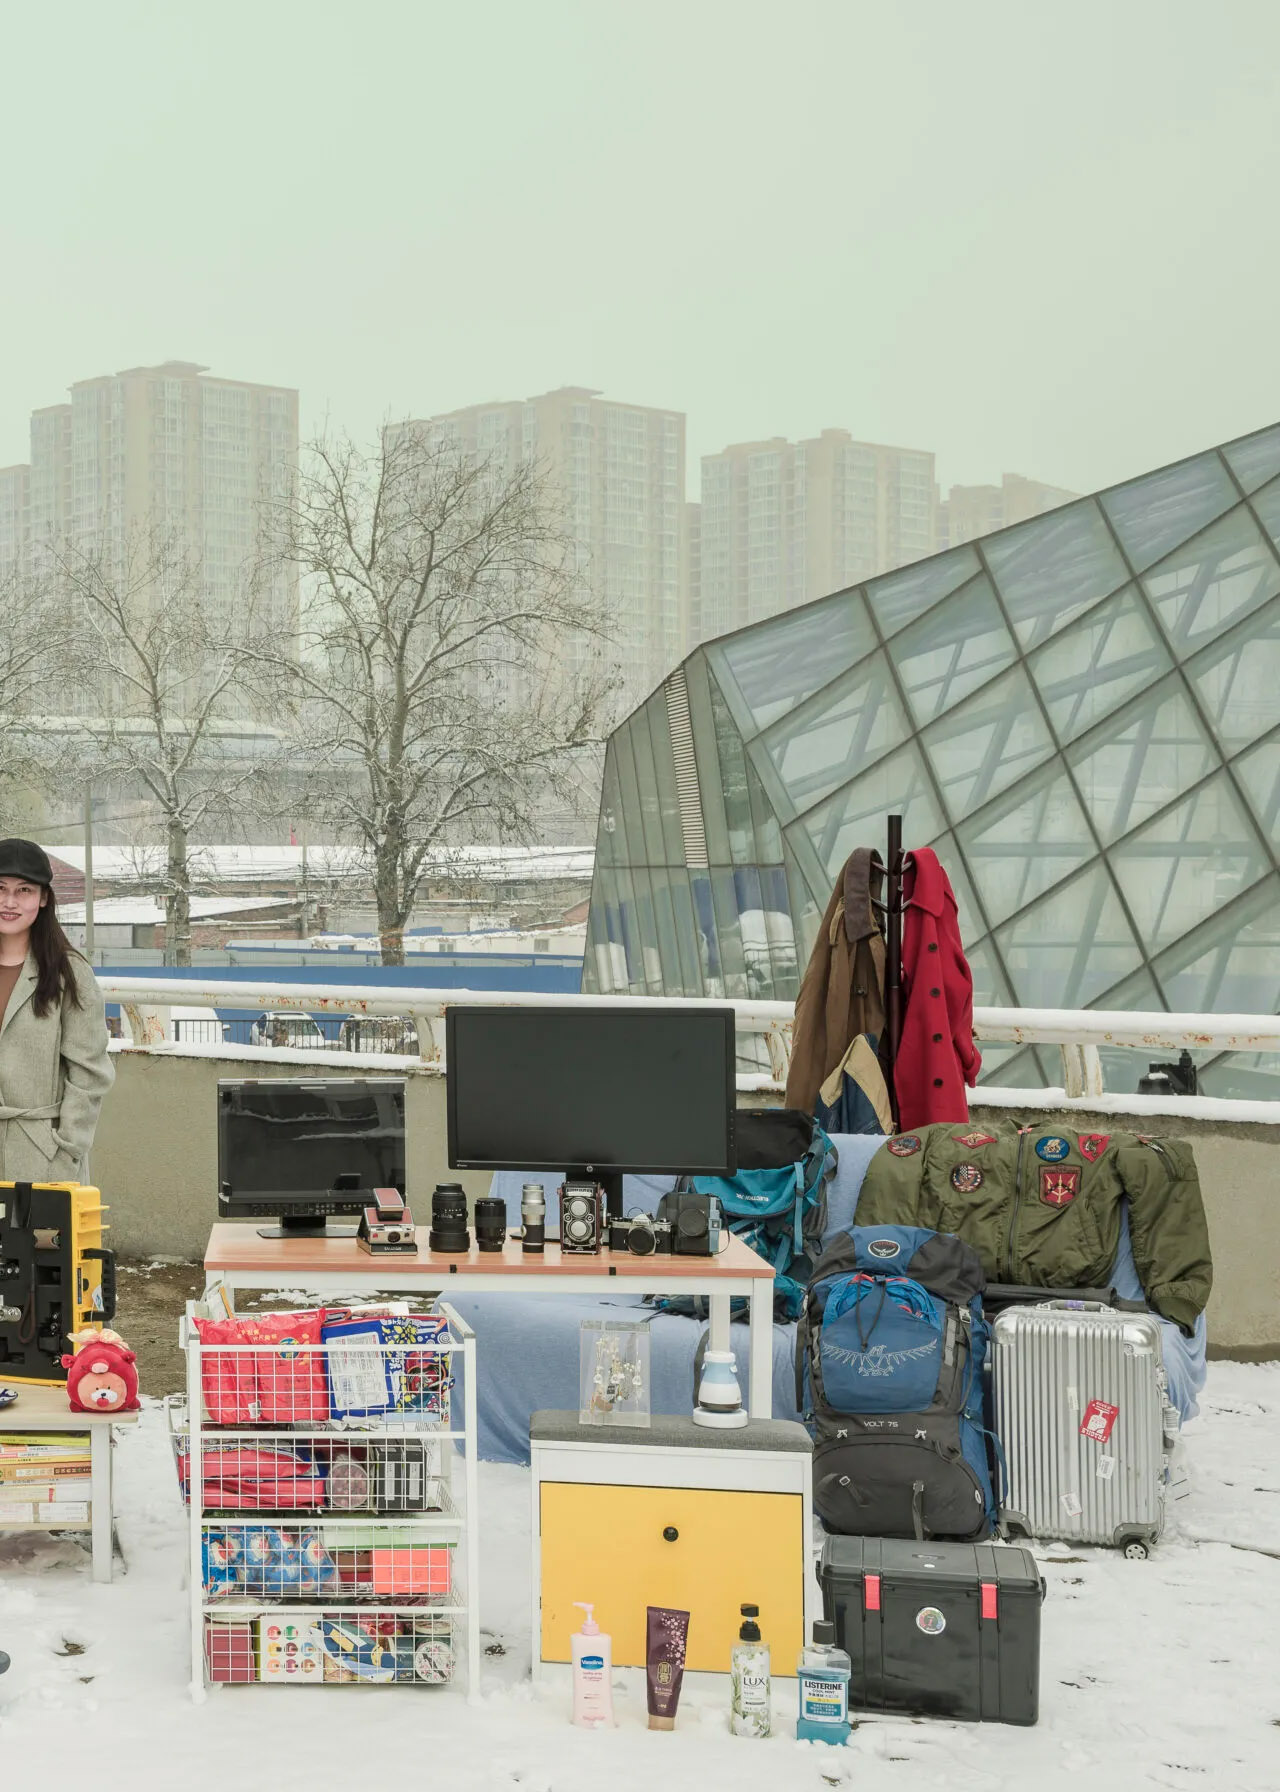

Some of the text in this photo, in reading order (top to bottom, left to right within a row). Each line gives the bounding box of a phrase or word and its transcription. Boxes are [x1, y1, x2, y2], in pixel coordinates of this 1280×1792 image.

[863, 1420, 885, 1428] VOLT
[743, 1677, 766, 1686] LUX
[805, 1680, 843, 1691] LISTERINE
